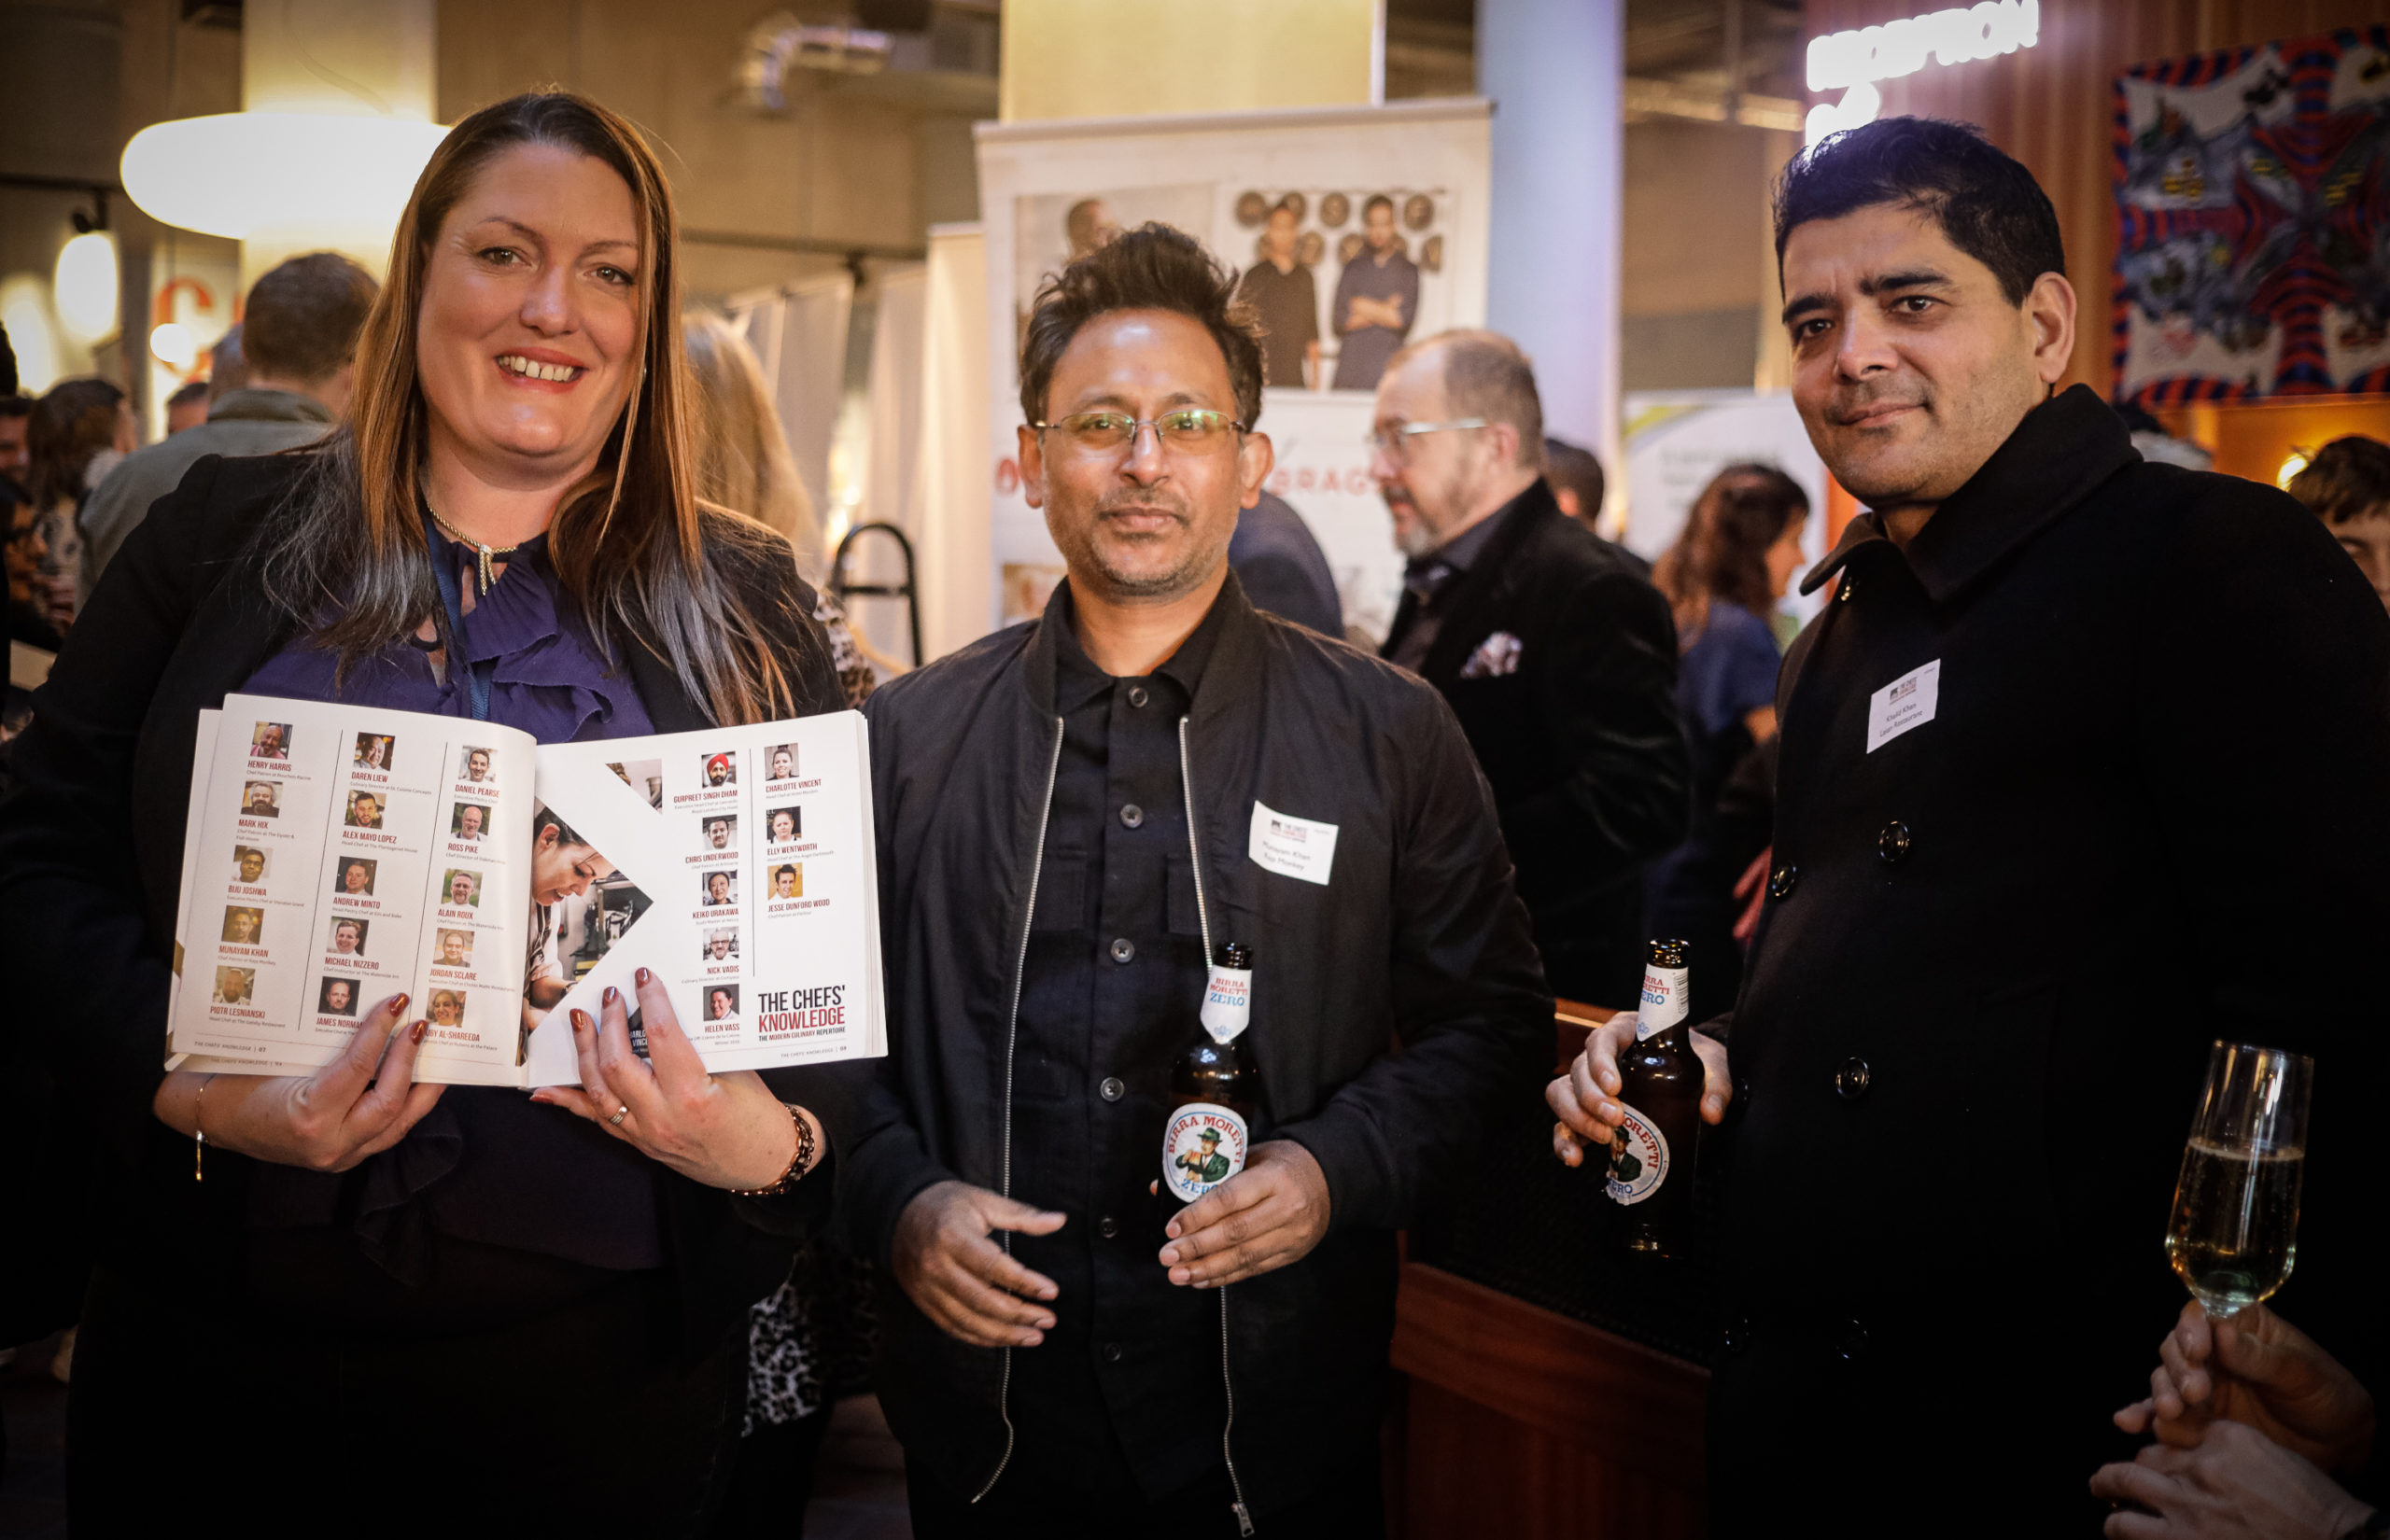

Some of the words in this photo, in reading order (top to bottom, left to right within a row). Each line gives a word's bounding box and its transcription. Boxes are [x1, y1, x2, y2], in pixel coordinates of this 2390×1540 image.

[248, 760, 268, 769] HENRY
[269, 762, 292, 772] HARRIS
[351, 771, 371, 781] DAREN
[373, 774, 388, 783] LIEW
[455, 784, 476, 794] DANIEL
[478, 787, 500, 798] PEARSE
[766, 782, 797, 793] CHARLOTTE
[799, 779, 821, 789] VINCENT
[673, 793, 701, 803] GURPREET
[703, 791, 720, 800] SINGH
[721, 789, 738, 798] DHAM
[238, 819, 256, 828] MARK
[258, 821, 268, 829] HIX
[343, 830, 358, 839] ALEX
[360, 832, 377, 842] MAYO
[378, 835, 397, 844] LOPEZ
[448, 843, 464, 852] ROSS
[465, 845, 478, 854] PIKE
[767, 847, 779, 855] ELLY
[782, 843, 818, 854] WENTWORTH
[685, 856, 702, 864] CHRIS
[703, 852, 738, 862] UNDERWOOD
[228, 885, 241, 893] BIJU
[242, 886, 267, 896] JOSHWA
[333, 897, 360, 907] ANDREW
[361, 900, 380, 909] MINTO
[768, 904, 784, 912] JESSE
[786, 900, 812, 910] DUNFORD
[813, 898, 830, 907] WOOD
[438, 908, 456, 918] ALAIN
[457, 910, 473, 920] ROUX
[692, 910, 710, 919] KEIKO
[710, 908, 739, 917] URAKAWA
[218, 945, 250, 955] MUNAYAM
[251, 948, 269, 958] KHAN
[325, 957, 352, 967] MICHAEL
[353, 960, 379, 970] NIZZERO
[430, 968, 453, 978] JORDAN
[454, 971, 477, 980] SCLARE
[1216, 978, 1244, 987] BIRRA
[1644, 975, 1663, 986] RRA
[1643, 983, 1670, 994] RETTI
[758, 991, 788, 1013] THE
[793, 985, 845, 1010] CHEFS'
[1210, 993, 1245, 1006] ZERO
[1641, 990, 1665, 1005] ERO
[210, 1006, 228, 1015] PIOTR
[229, 1008, 266, 1019] LESNIANSKI
[316, 1017, 337, 1027] JAMES
[338, 1020, 363, 1029] NORMA
[759, 1006, 845, 1033] KNOWLEDGE
[705, 1024, 724, 1033] HELEN
[725, 1023, 740, 1031] VASS
[817, 1026, 846, 1035] REPERTOIRE
[426, 1028, 438, 1038] UBY
[439, 1030, 480, 1042] AL-SHAREEDA
[1169, 1116, 1199, 1154] BIRRA
[1203, 1116, 1243, 1163] MORETTI
[1624, 1117, 1659, 1169] ORETTI
